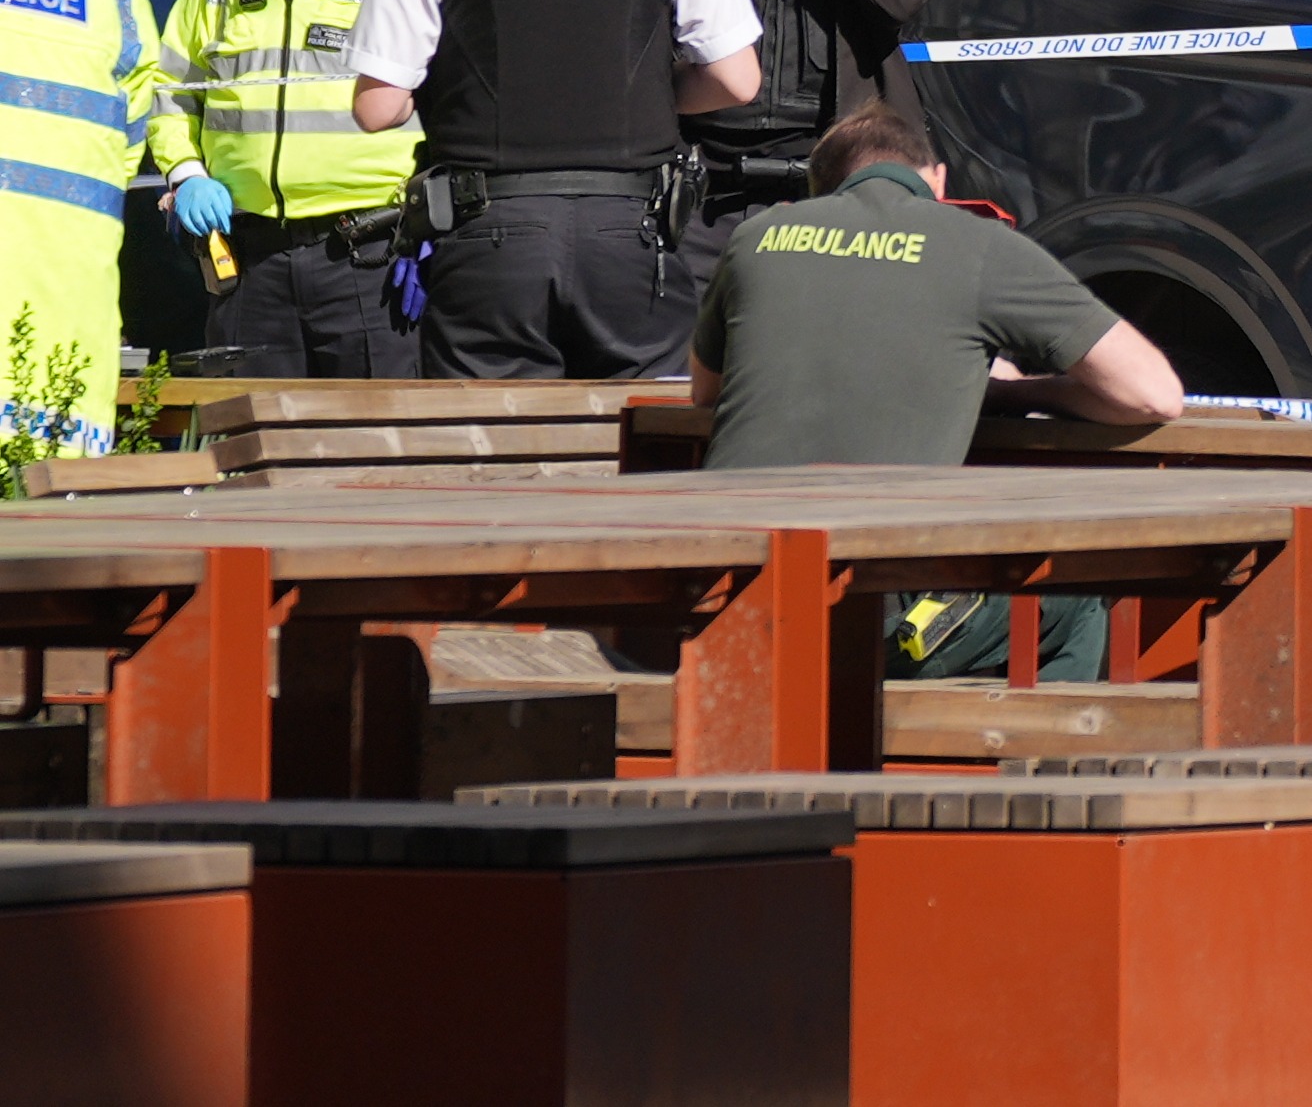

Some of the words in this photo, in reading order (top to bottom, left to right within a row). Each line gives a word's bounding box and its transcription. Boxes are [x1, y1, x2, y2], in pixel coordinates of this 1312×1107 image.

[1041, 38, 1083, 55] NOT
[1092, 36, 1121, 53] DO
[1128, 34, 1179, 51] LINE
[1185, 30, 1266, 49] POLICE
[957, 40, 1033, 57] CROSS
[755, 224, 926, 263] AMBULANCE
